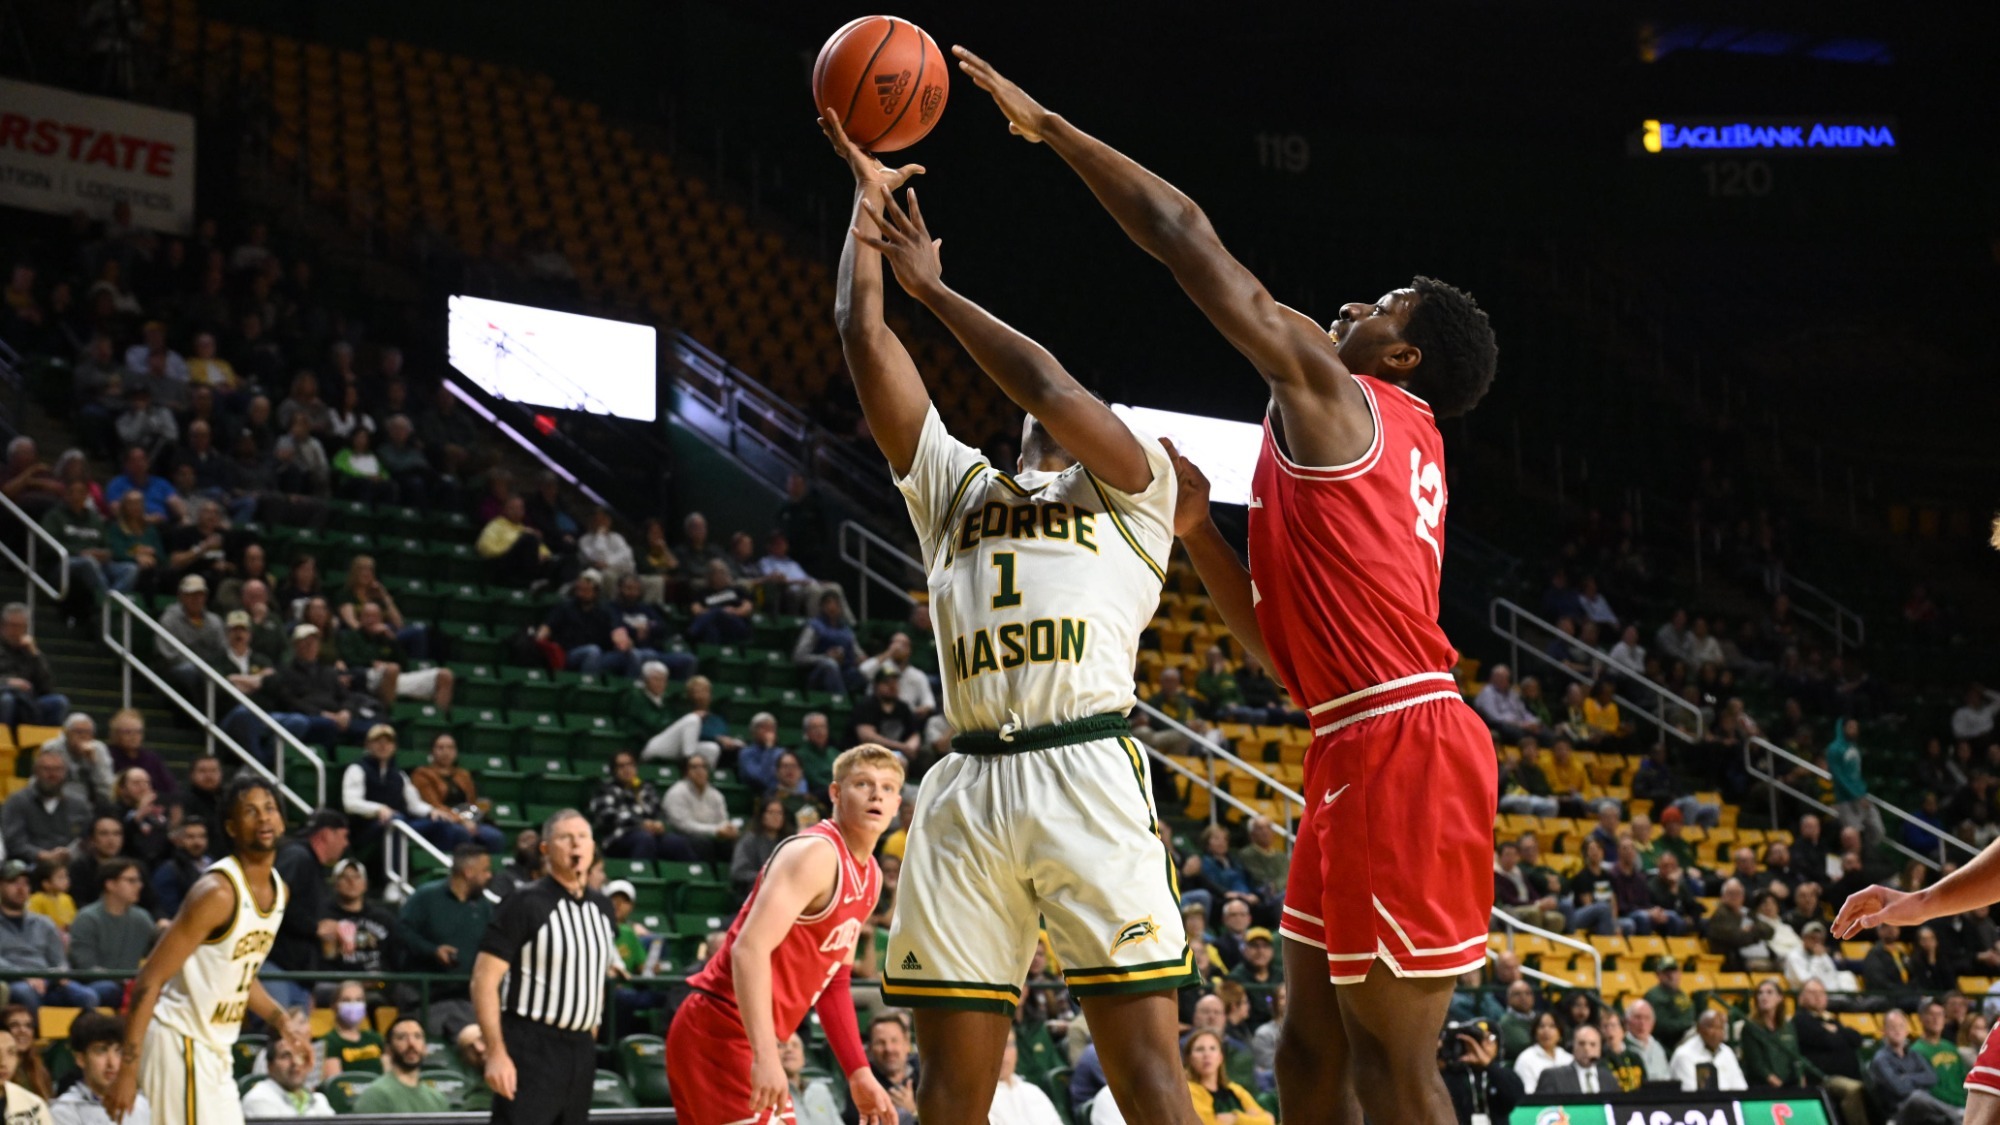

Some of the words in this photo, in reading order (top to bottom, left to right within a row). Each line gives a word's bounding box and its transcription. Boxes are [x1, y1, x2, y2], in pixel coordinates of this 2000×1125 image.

[1254, 131, 1312, 173] 119
[0, 166, 51, 189] TION
[1701, 159, 1773, 197] 120
[944, 501, 1099, 570] EORGE
[990, 551, 1022, 611] 1
[210, 1001, 247, 1025] MAS
